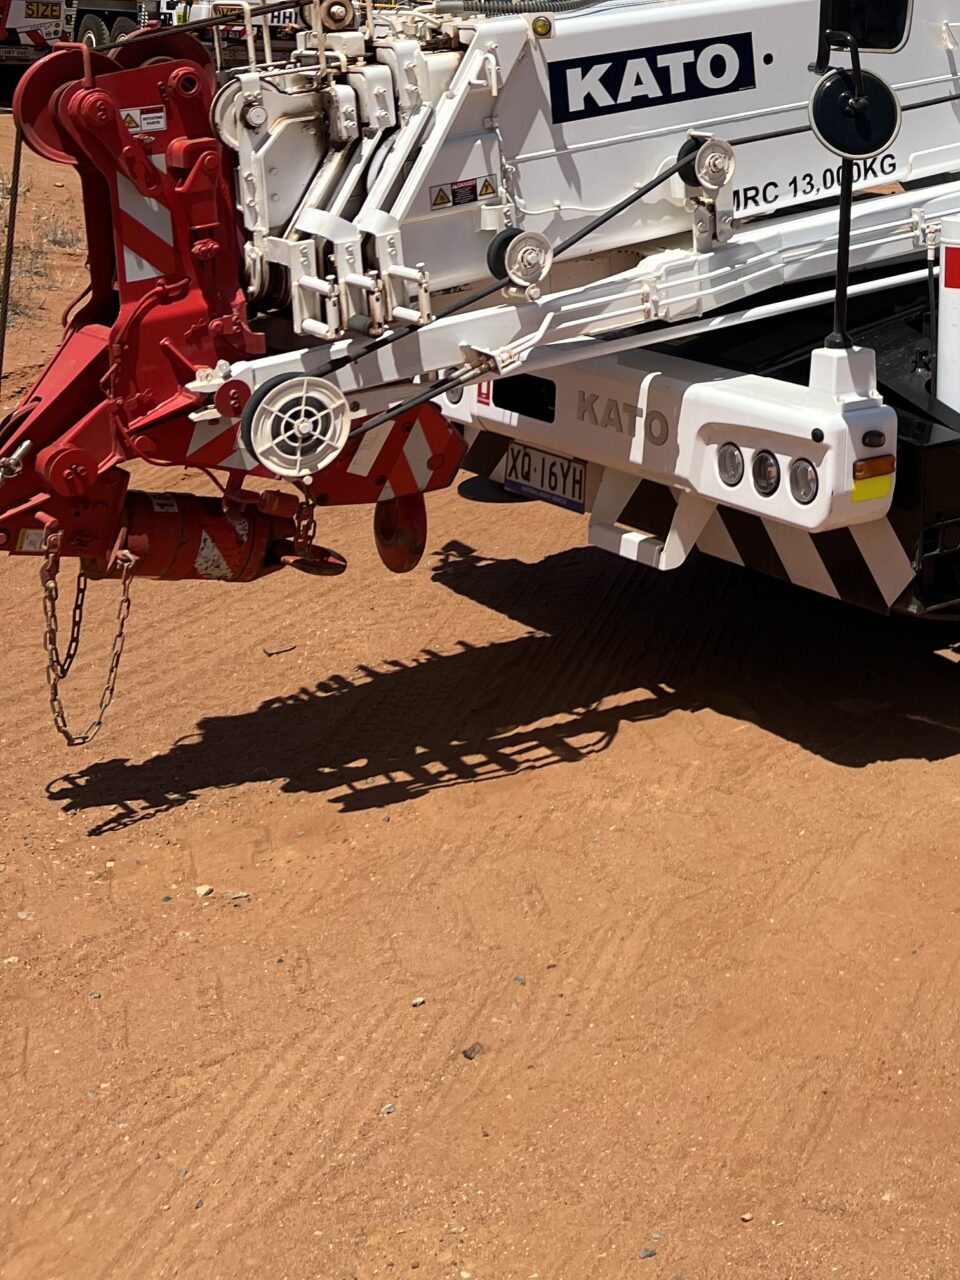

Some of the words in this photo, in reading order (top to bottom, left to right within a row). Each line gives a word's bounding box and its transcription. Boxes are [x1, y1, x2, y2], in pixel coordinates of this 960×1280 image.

[25, 2, 59, 18] SIZE
[270, 10, 298, 25] HHI
[566, 43, 740, 112] KATO
[576, 390, 669, 446] KATO
